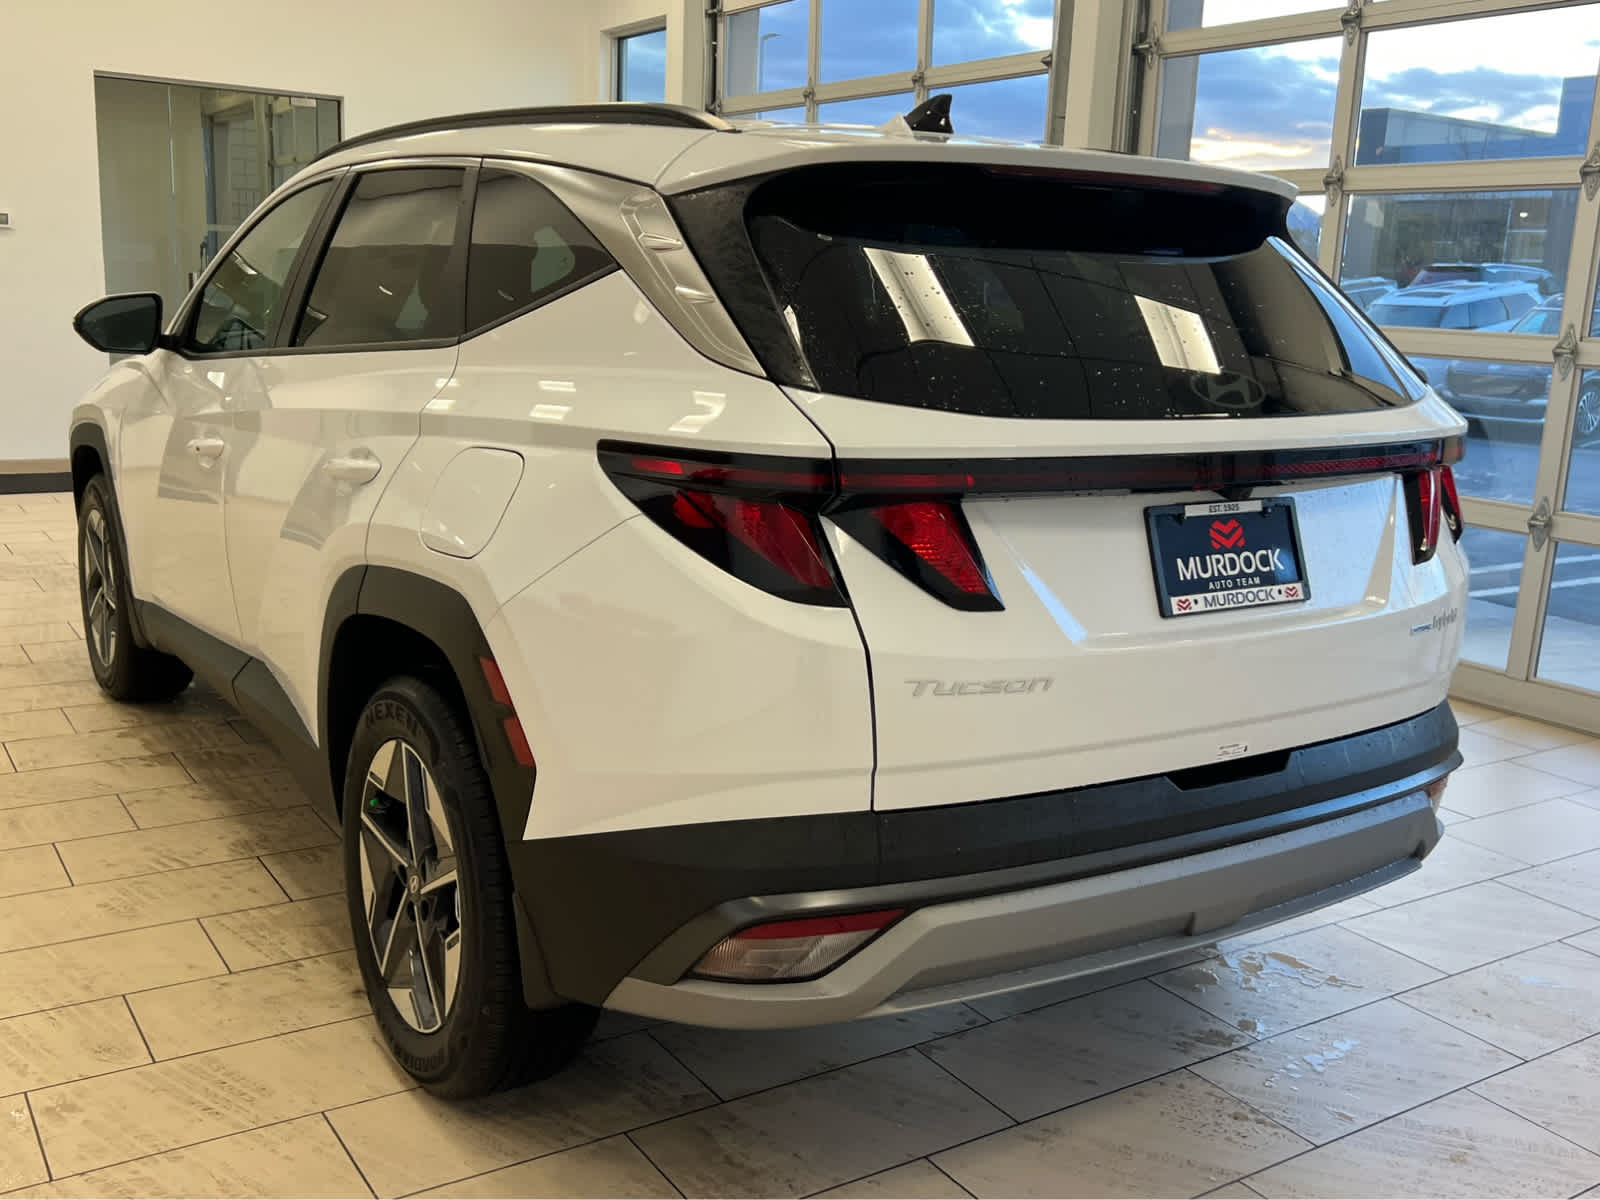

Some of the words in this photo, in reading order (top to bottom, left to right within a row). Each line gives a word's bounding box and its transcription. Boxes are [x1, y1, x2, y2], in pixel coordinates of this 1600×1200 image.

[1209, 504, 1222, 513] EST.
[1177, 548, 1284, 581] MURDOCK
[1208, 580, 1233, 590] AUTO
[1236, 577, 1261, 586] TEAM
[1203, 588, 1276, 609] MURDOCK
